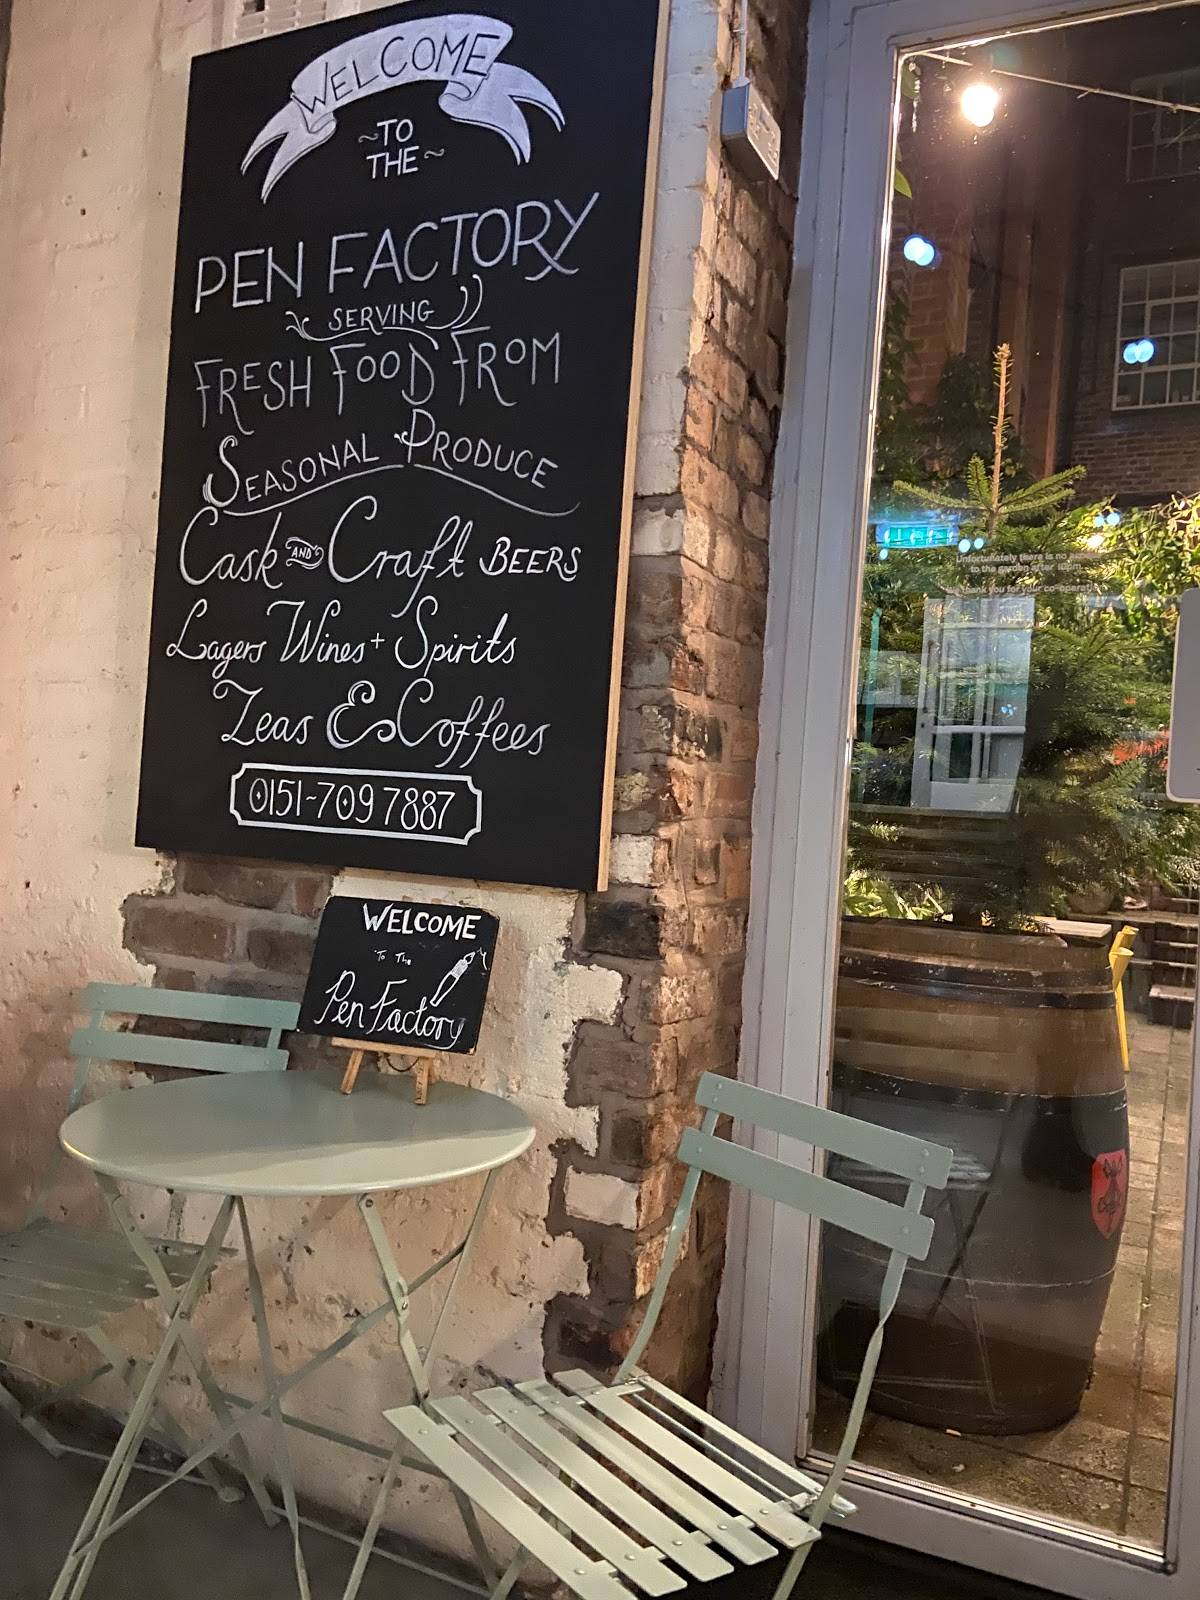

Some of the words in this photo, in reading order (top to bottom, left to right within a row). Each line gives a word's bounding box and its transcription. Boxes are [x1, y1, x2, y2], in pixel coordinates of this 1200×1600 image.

[291, 33, 500, 115] WELCOME
[376, 118, 414, 146] TO
[366, 145, 419, 179] THE
[194, 241, 304, 314] PEN
[328, 192, 600, 295] FACTORY
[328, 300, 435, 335] SERVING
[195, 355, 311, 435] FRESH
[331, 342, 439, 415] FOOD
[451, 326, 560, 406] FROM
[203, 433, 379, 507] SEASONAL
[395, 408, 558, 489] PRODUCE
[180, 505, 284, 588] Cask
[328, 495, 474, 618] Craft
[479, 536, 582, 580] BEERS
[956, 553, 1017, 564] Unfortunately
[1019, 553, 1043, 563] there
[1045, 552, 1054, 560] is
[1056, 552, 1067, 560] no
[970, 565, 980, 573] to
[981, 565, 996, 573] the
[998, 563, 1030, 574] garden
[1031, 563, 1054, 572] after
[988, 585, 1005, 596] you
[1007, 584, 1020, 593] for
[1021, 585, 1043, 596] your
[165, 599, 268, 679] Lagers
[267, 599, 368, 666] Wines
[394, 595, 518, 677] Spirits
[212, 679, 315, 748] Teas
[396, 678, 551, 769] Coffees
[248, 777, 375, 825] 0151-709
[382, 786, 457, 833] 7887
[362, 902, 482, 941] WELCOME
[376, 949, 388, 961] To
[313, 969, 365, 1029] Pen
[366, 978, 467, 1050] Factory
